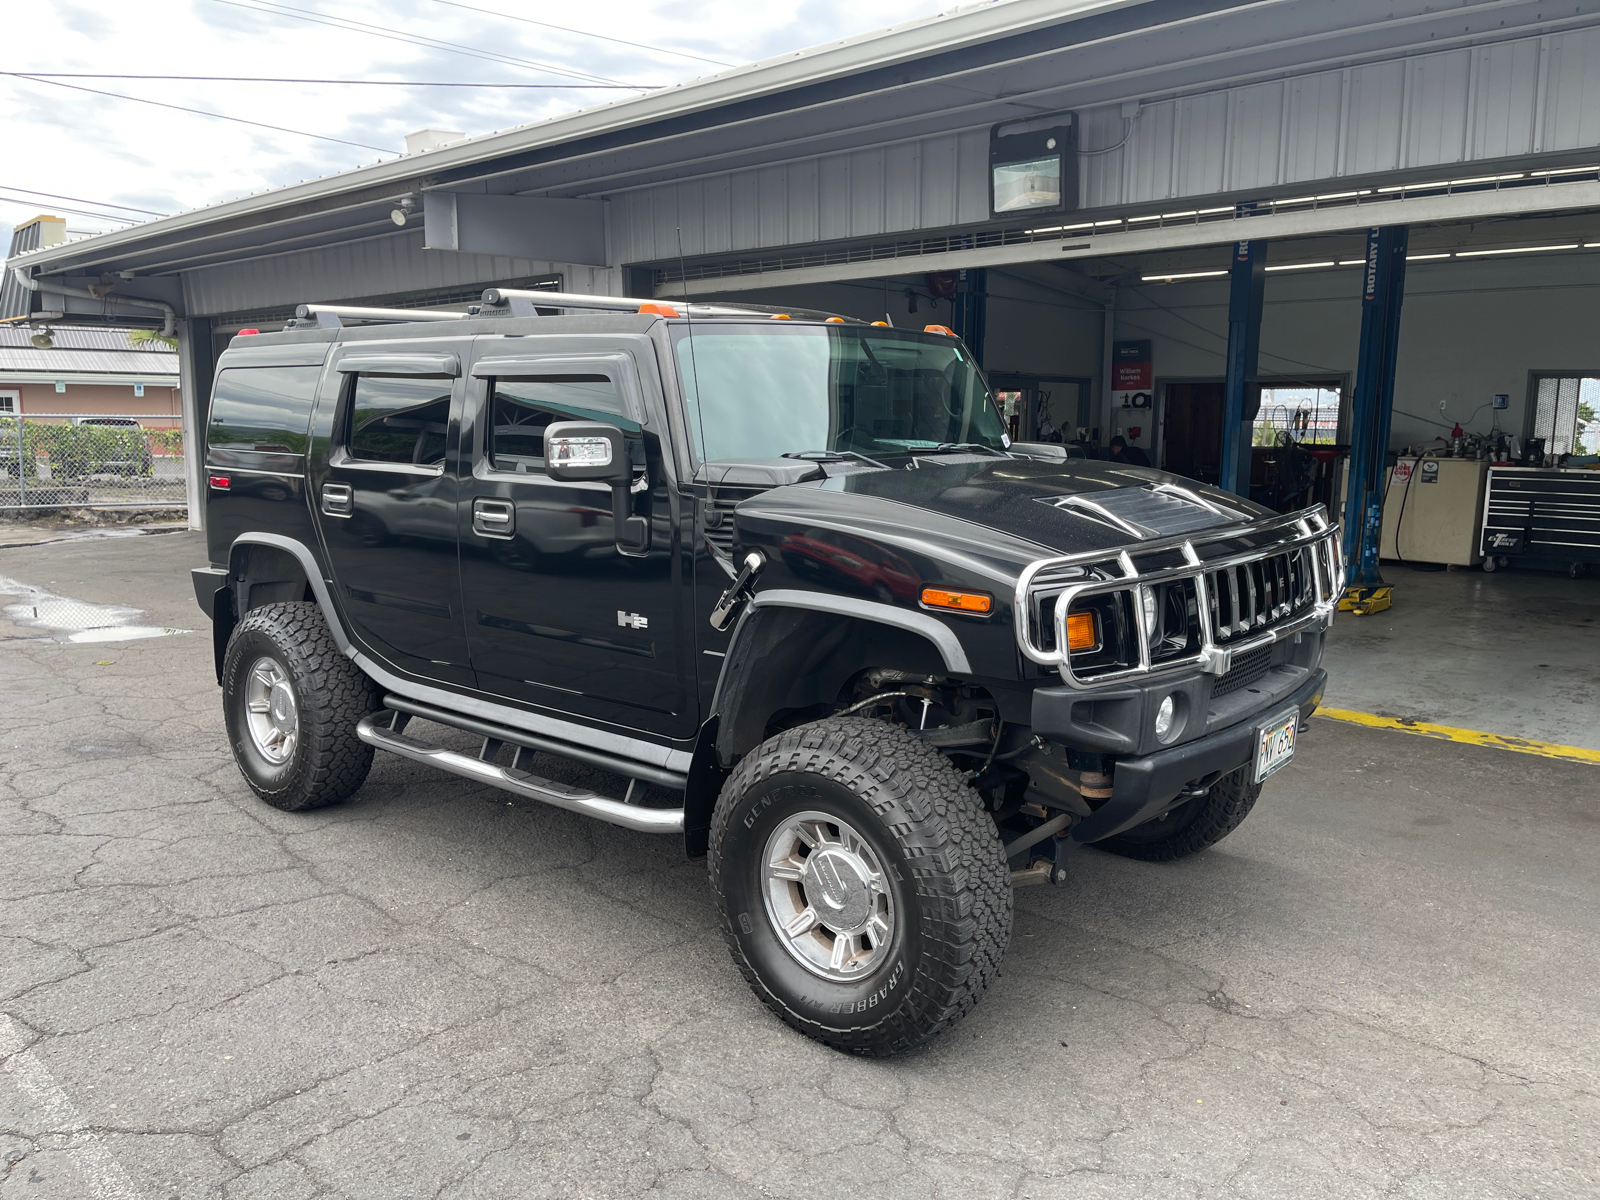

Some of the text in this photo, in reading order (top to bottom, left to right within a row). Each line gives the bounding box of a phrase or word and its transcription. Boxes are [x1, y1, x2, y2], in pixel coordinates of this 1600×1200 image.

[1366, 242, 1379, 294] ROTARY
[617, 610, 649, 630] H2
[1277, 724, 1296, 755] 652
[743, 784, 823, 830] GENERAL
[829, 959, 905, 1015] GRABBER
